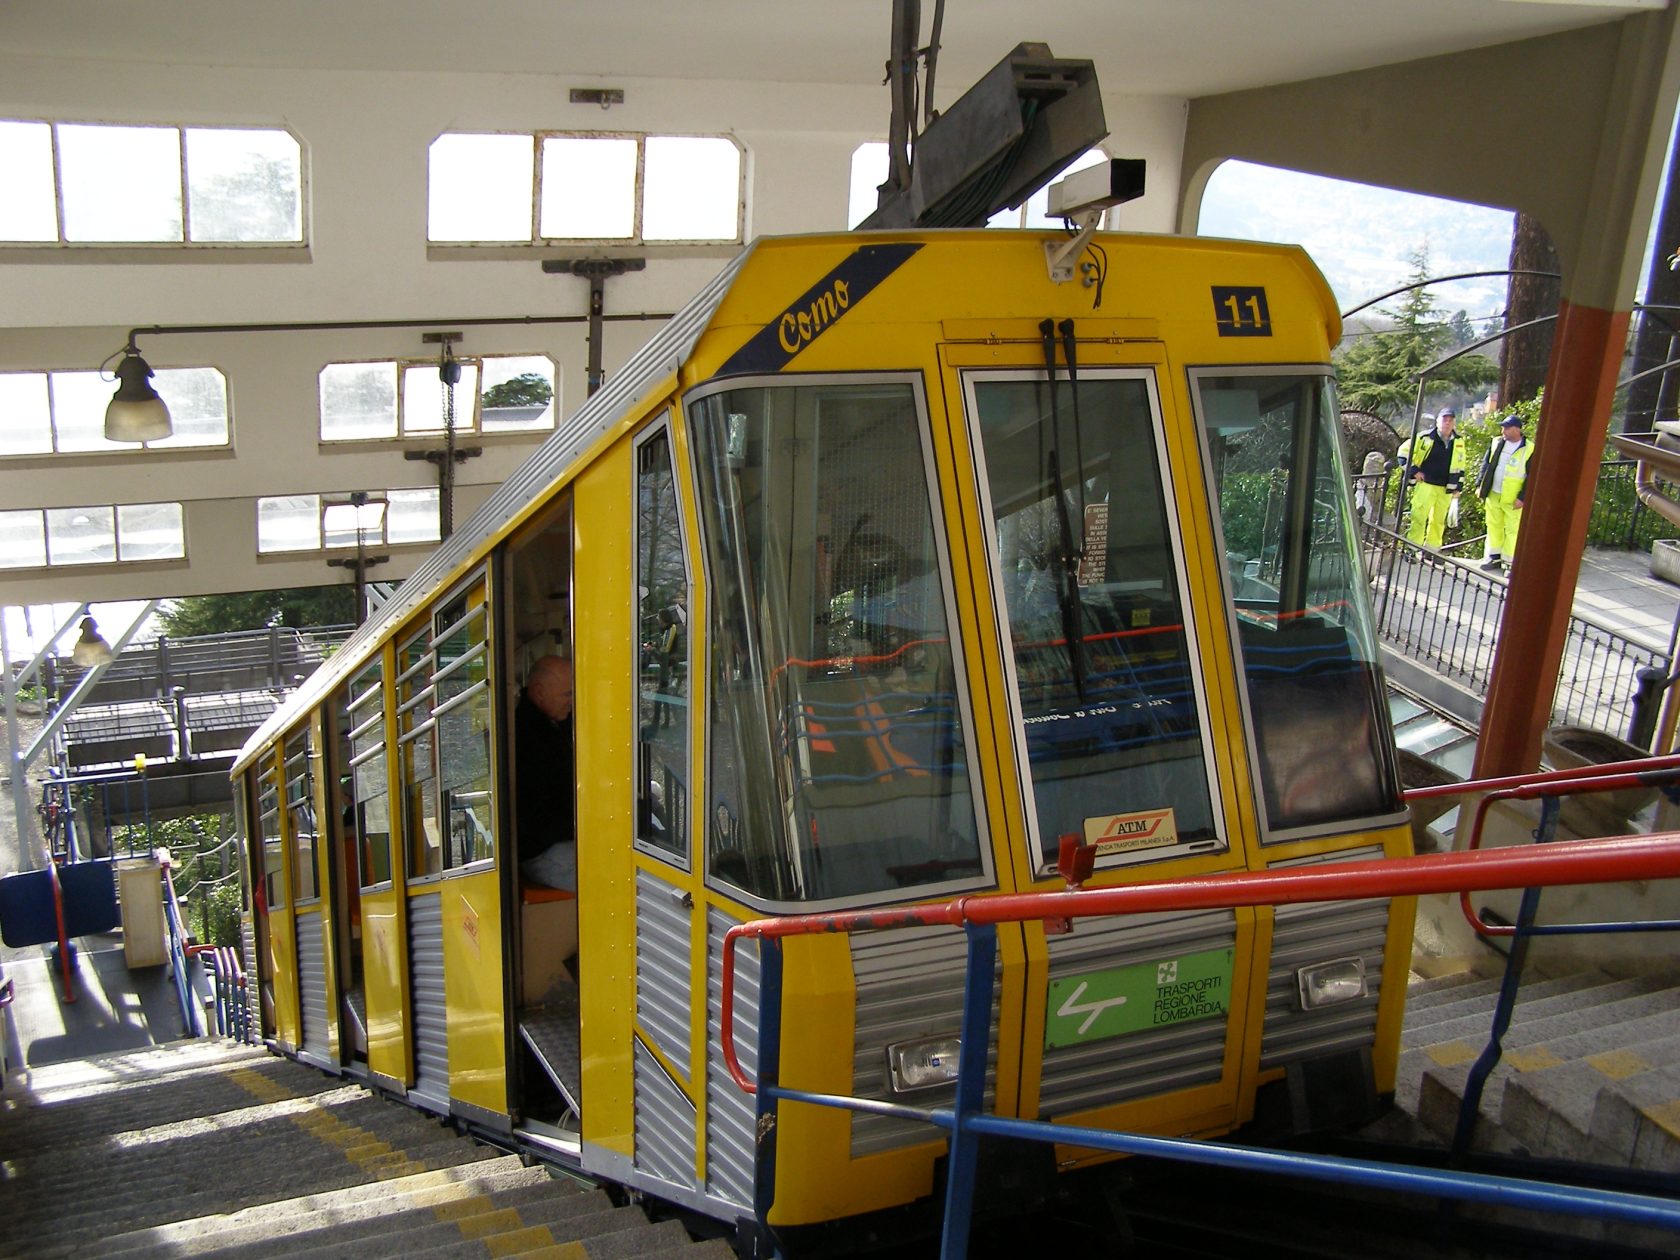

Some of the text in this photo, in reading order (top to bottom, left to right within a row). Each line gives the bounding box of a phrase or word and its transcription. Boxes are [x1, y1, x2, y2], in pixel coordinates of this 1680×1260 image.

[778, 279, 849, 353] Como
[1224, 295, 1262, 328] 11
[1117, 820, 1147, 835] ATM
[1113, 840, 1140, 849] TRASPORTI
[1140, 837, 1162, 846] MILANESI
[1156, 976, 1222, 998] TRASPORTI
[1154, 991, 1206, 1011] REGIONE
[1153, 1001, 1222, 1025] LOMBARDIA
